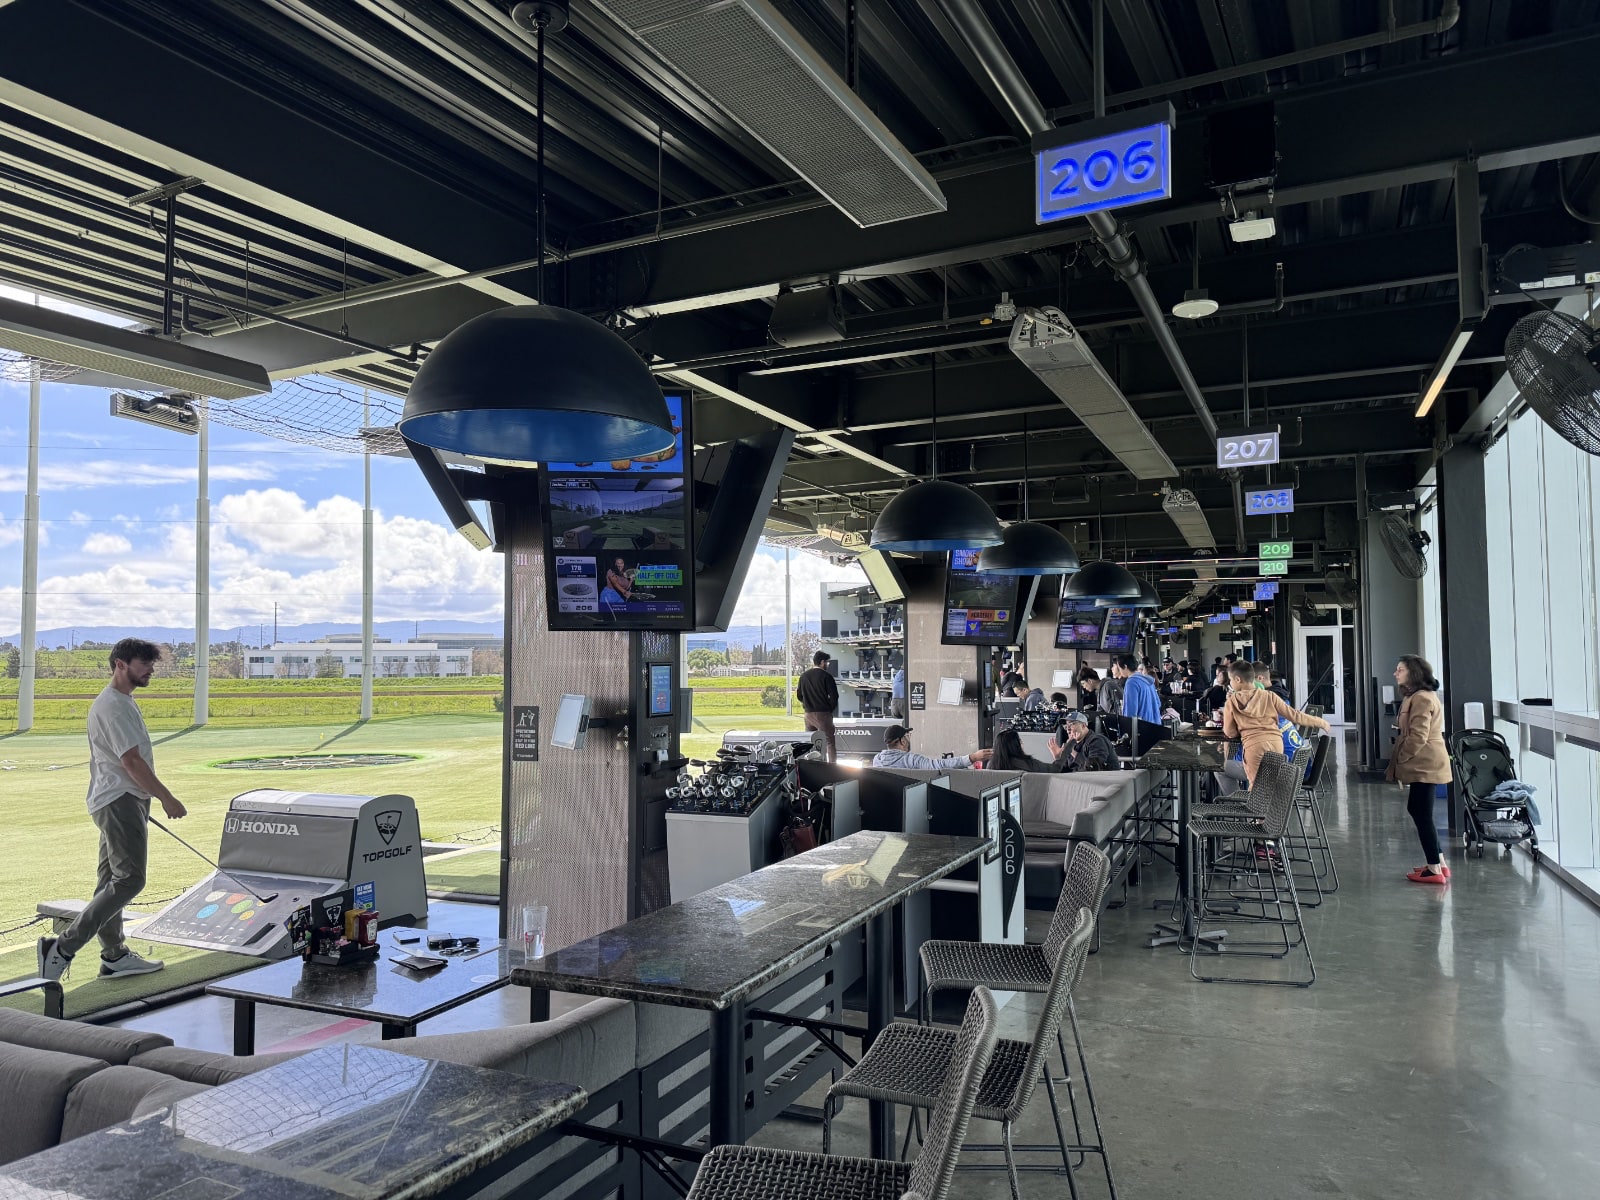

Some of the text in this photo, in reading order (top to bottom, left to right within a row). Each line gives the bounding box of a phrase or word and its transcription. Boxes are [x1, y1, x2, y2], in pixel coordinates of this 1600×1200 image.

[1050, 140, 1156, 201] 206
[1224, 438, 1273, 460] 207
[1251, 492, 1289, 509] 208
[955, 549, 976, 558] SMOKE
[1262, 544, 1290, 555] 209
[954, 557, 973, 566] SHOW
[1263, 562, 1284, 572] 210
[240, 821, 300, 836] HONDA
[362, 845, 412, 864] TOPGOLF
[1004, 828, 1016, 875] 206
